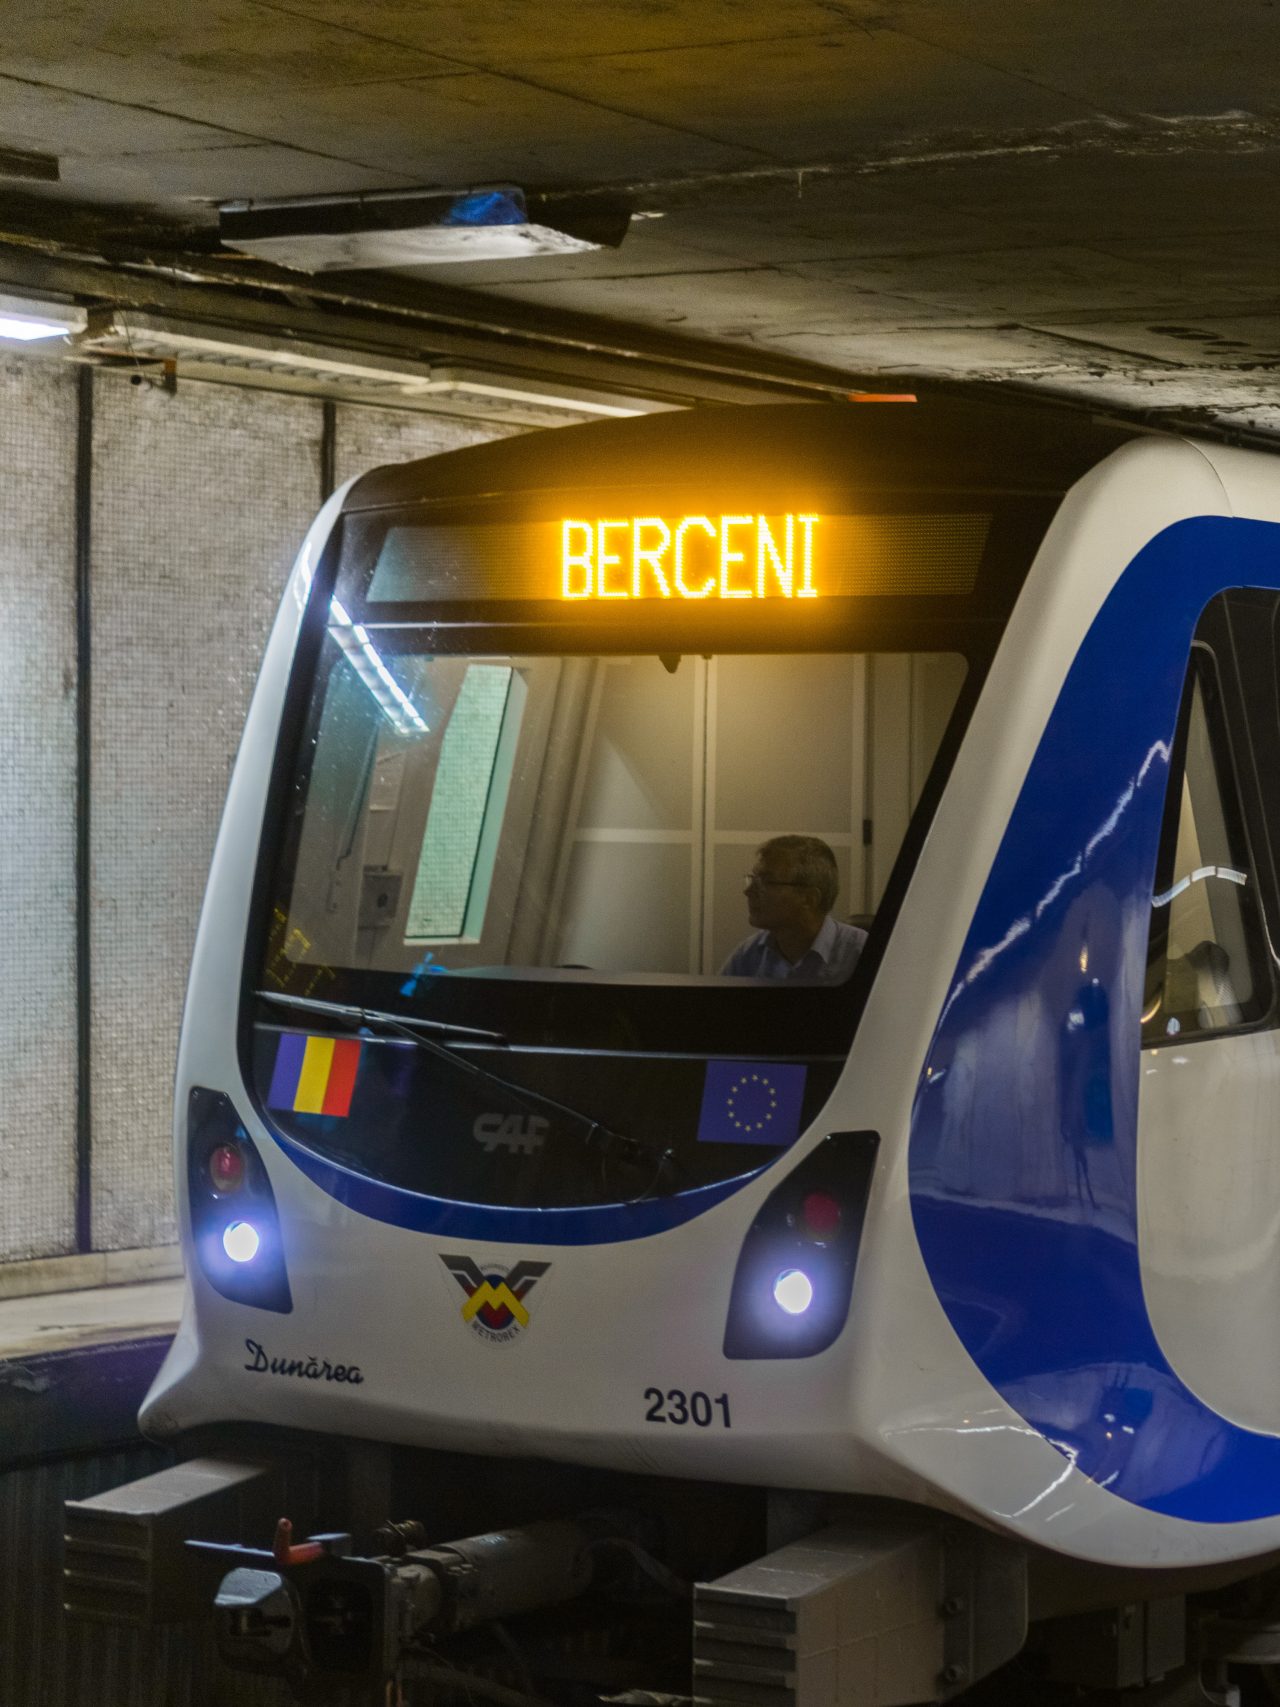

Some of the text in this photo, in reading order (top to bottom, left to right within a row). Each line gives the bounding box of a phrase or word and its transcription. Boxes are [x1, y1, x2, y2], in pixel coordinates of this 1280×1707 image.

[561, 514, 820, 599] BERCENI
[244, 1338, 364, 1384] Dunărea
[644, 1387, 731, 1428] 2301
